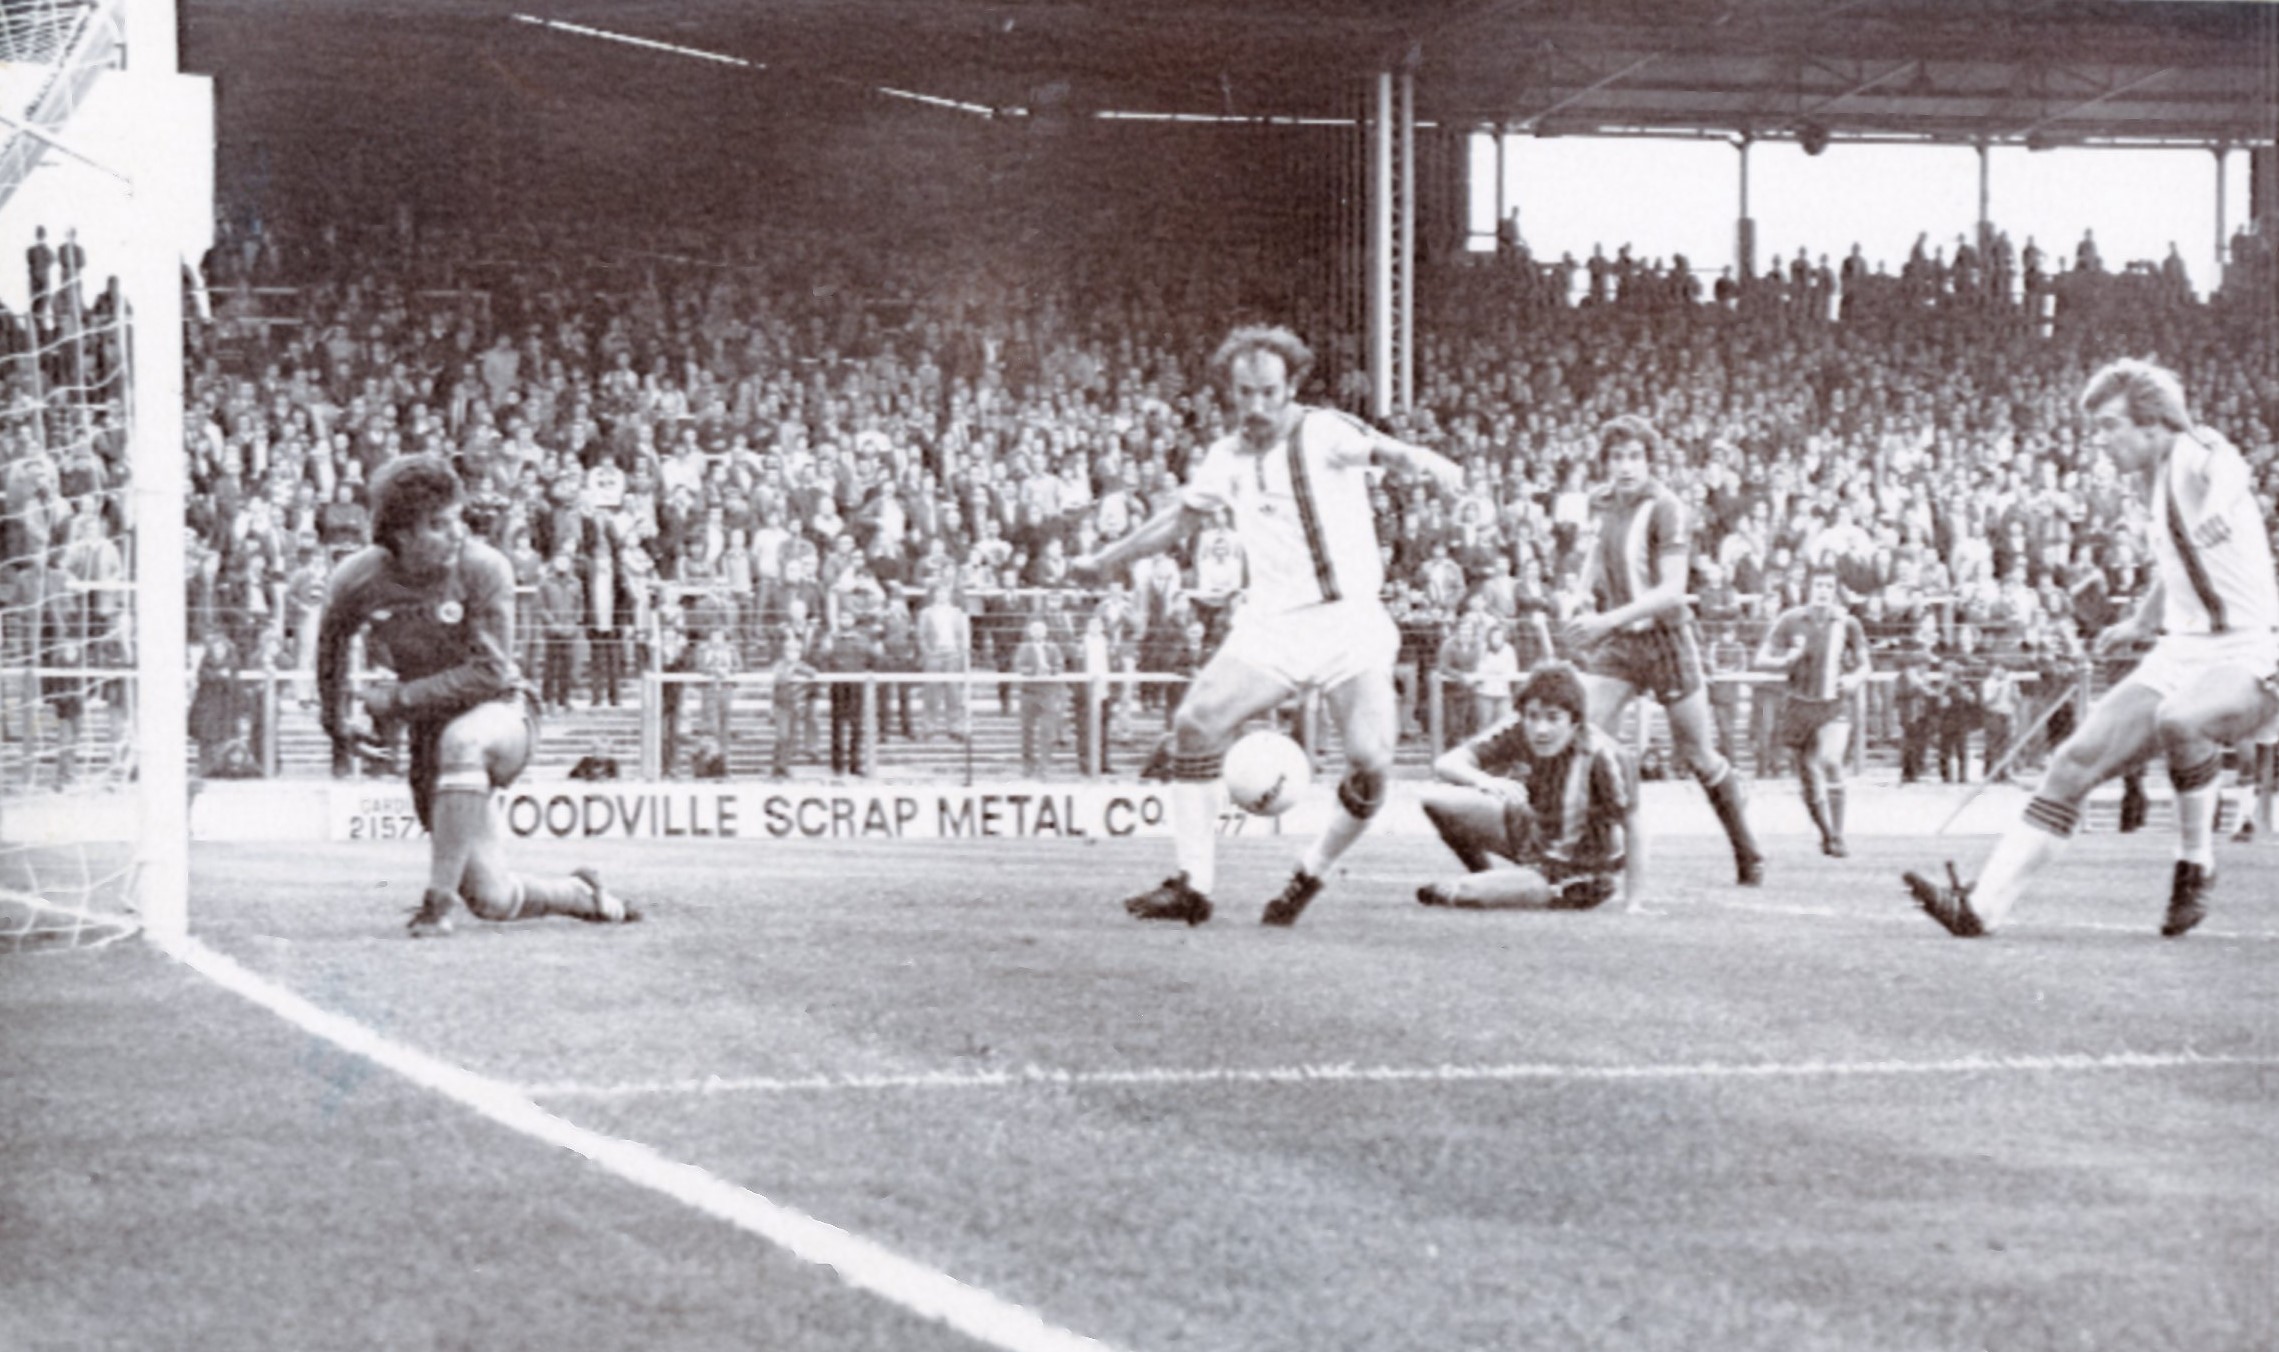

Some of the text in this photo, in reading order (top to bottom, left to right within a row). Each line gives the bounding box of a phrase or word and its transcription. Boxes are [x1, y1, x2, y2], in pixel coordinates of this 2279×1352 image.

[348, 815, 427, 840] 2157
[497, 794, 738, 838] OODVILLE
[761, 795, 919, 838] SCRAP
[935, 794, 1087, 838] METAL
